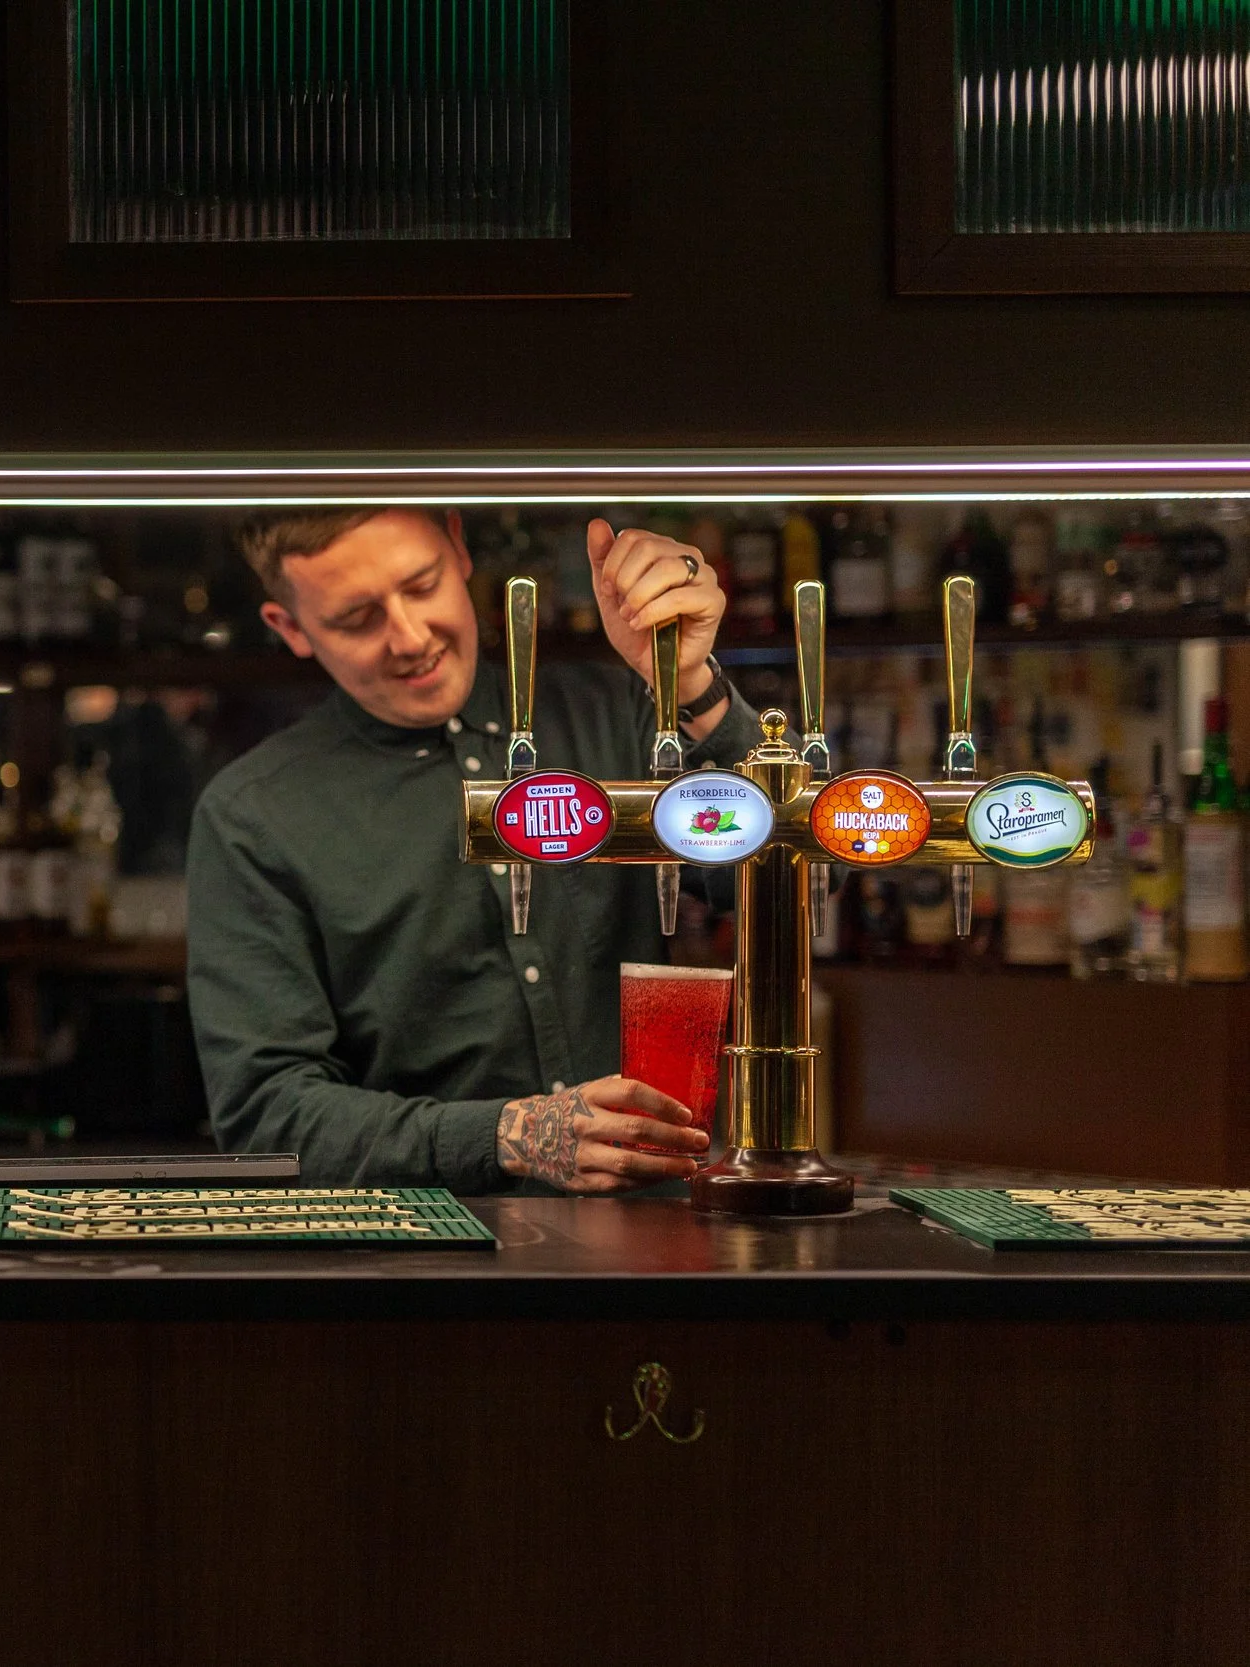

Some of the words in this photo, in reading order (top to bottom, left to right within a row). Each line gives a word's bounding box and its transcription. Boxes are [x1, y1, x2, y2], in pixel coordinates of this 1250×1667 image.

[530, 786, 572, 795] CAMDEN
[680, 788, 747, 799] REKORDERLIG
[863, 791, 882, 800] SALT
[525, 798, 582, 838] HELLS
[834, 812, 909, 831] HUCKABACK
[986, 802, 1066, 839] Staropramen
